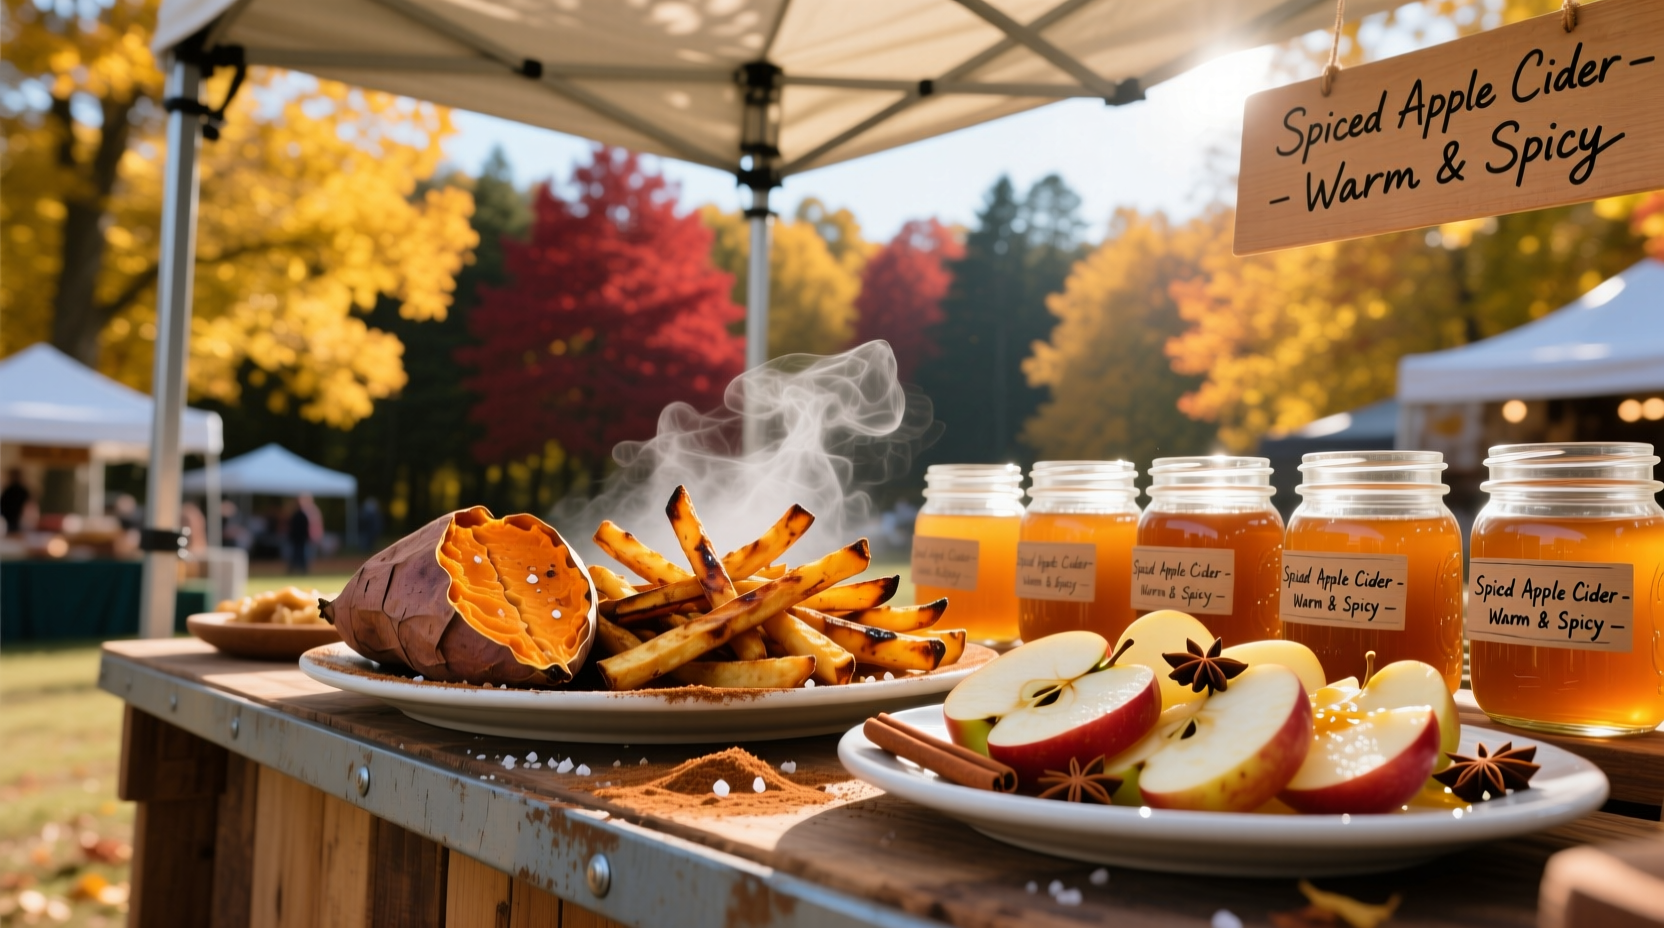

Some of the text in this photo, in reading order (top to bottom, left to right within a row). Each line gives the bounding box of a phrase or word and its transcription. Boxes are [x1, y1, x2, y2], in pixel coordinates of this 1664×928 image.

[1275, 89, 1388, 165] Spiced
[1397, 68, 1497, 140] Apple
[1511, 41, 1622, 104] Cider
[1305, 160, 1421, 213] Warm
[1435, 140, 1467, 185] &
[1485, 119, 1626, 188] Spicy
[1159, 560, 1186, 581] Apple
[1316, 567, 1350, 593] Apple
[1354, 569, 1394, 589] Cider
[1293, 592, 1323, 610] Warm
[1327, 594, 1337, 612] &
[1342, 595, 1380, 622] Spicy
[1521, 577, 1566, 608] Apple
[1572, 580, 1619, 604] Cider
[1489, 607, 1530, 628] Warm
[1537, 610, 1550, 629] &
[1557, 610, 1605, 643] Spicy
